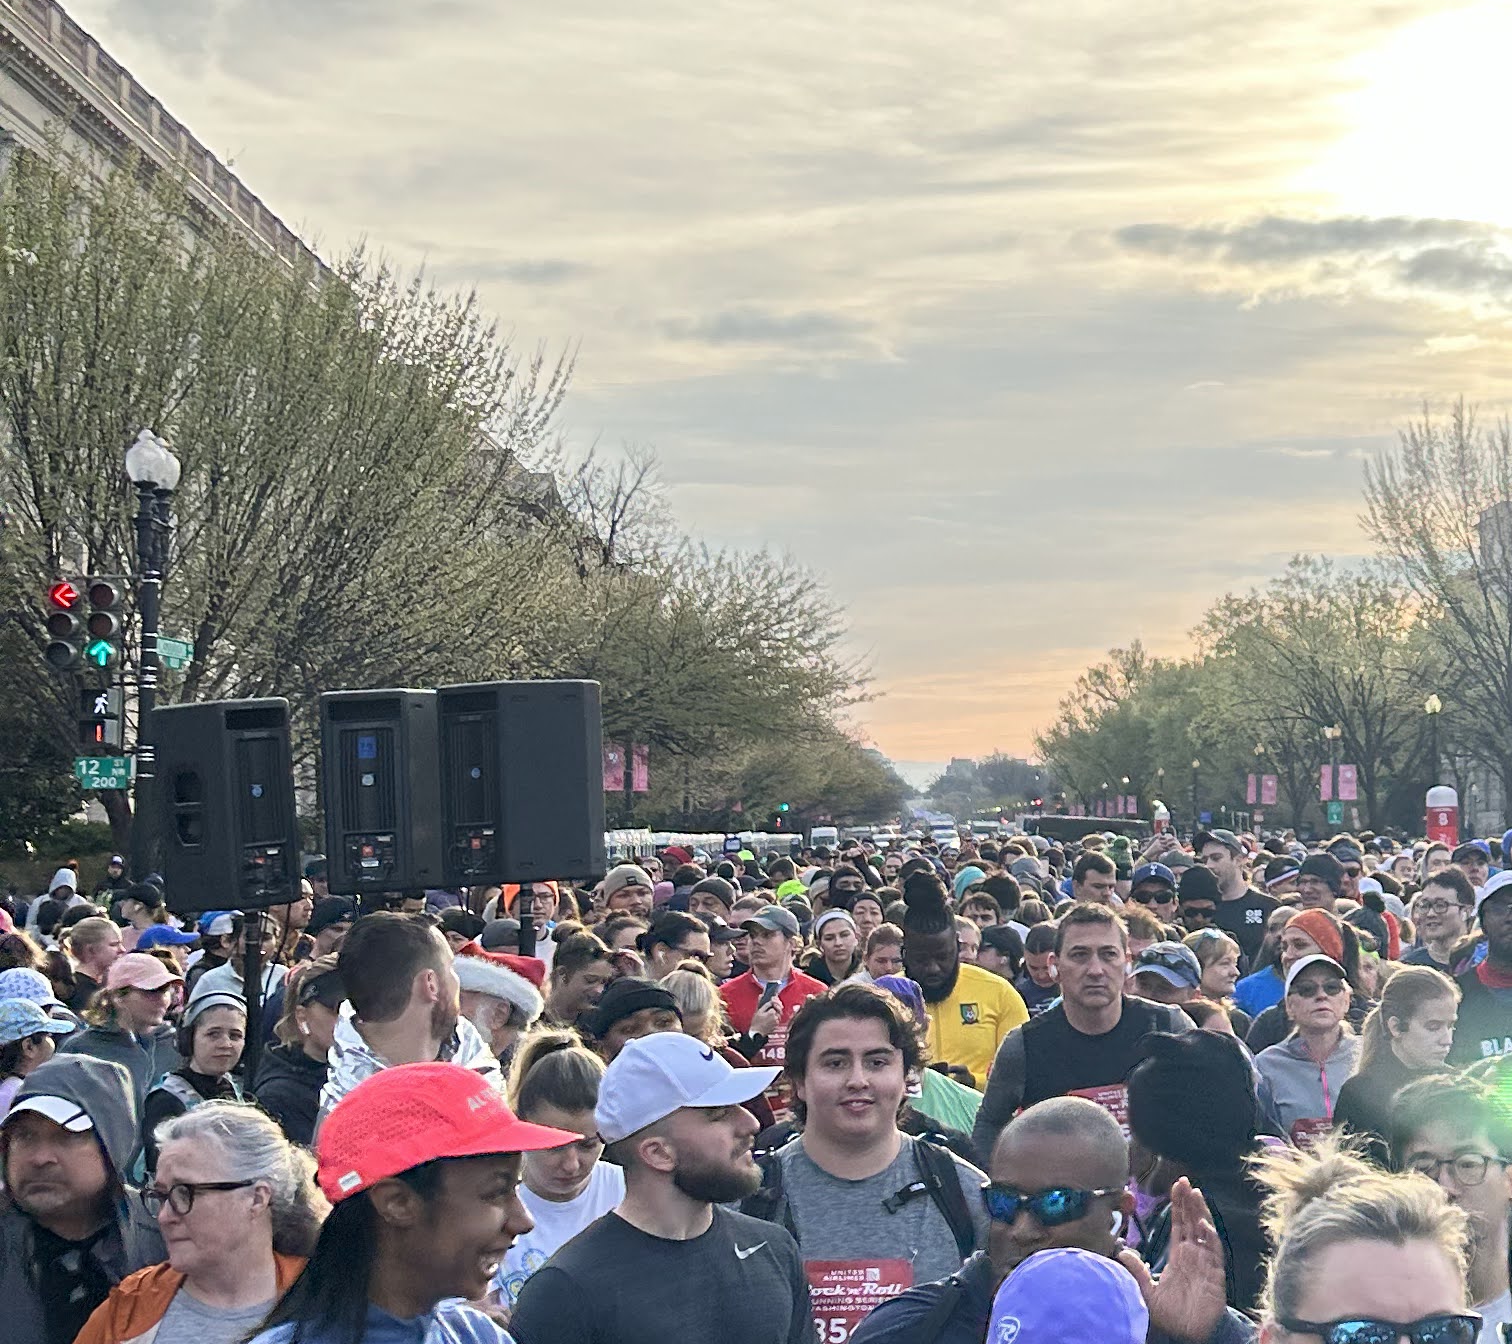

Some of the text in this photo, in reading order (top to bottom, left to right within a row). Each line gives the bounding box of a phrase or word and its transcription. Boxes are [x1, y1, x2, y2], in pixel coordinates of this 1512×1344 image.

[78, 759, 100, 775] 12
[91, 776, 117, 788] 200
[861, 1282, 903, 1295] Roll
[811, 1304, 876, 1312] ASHINGTON
